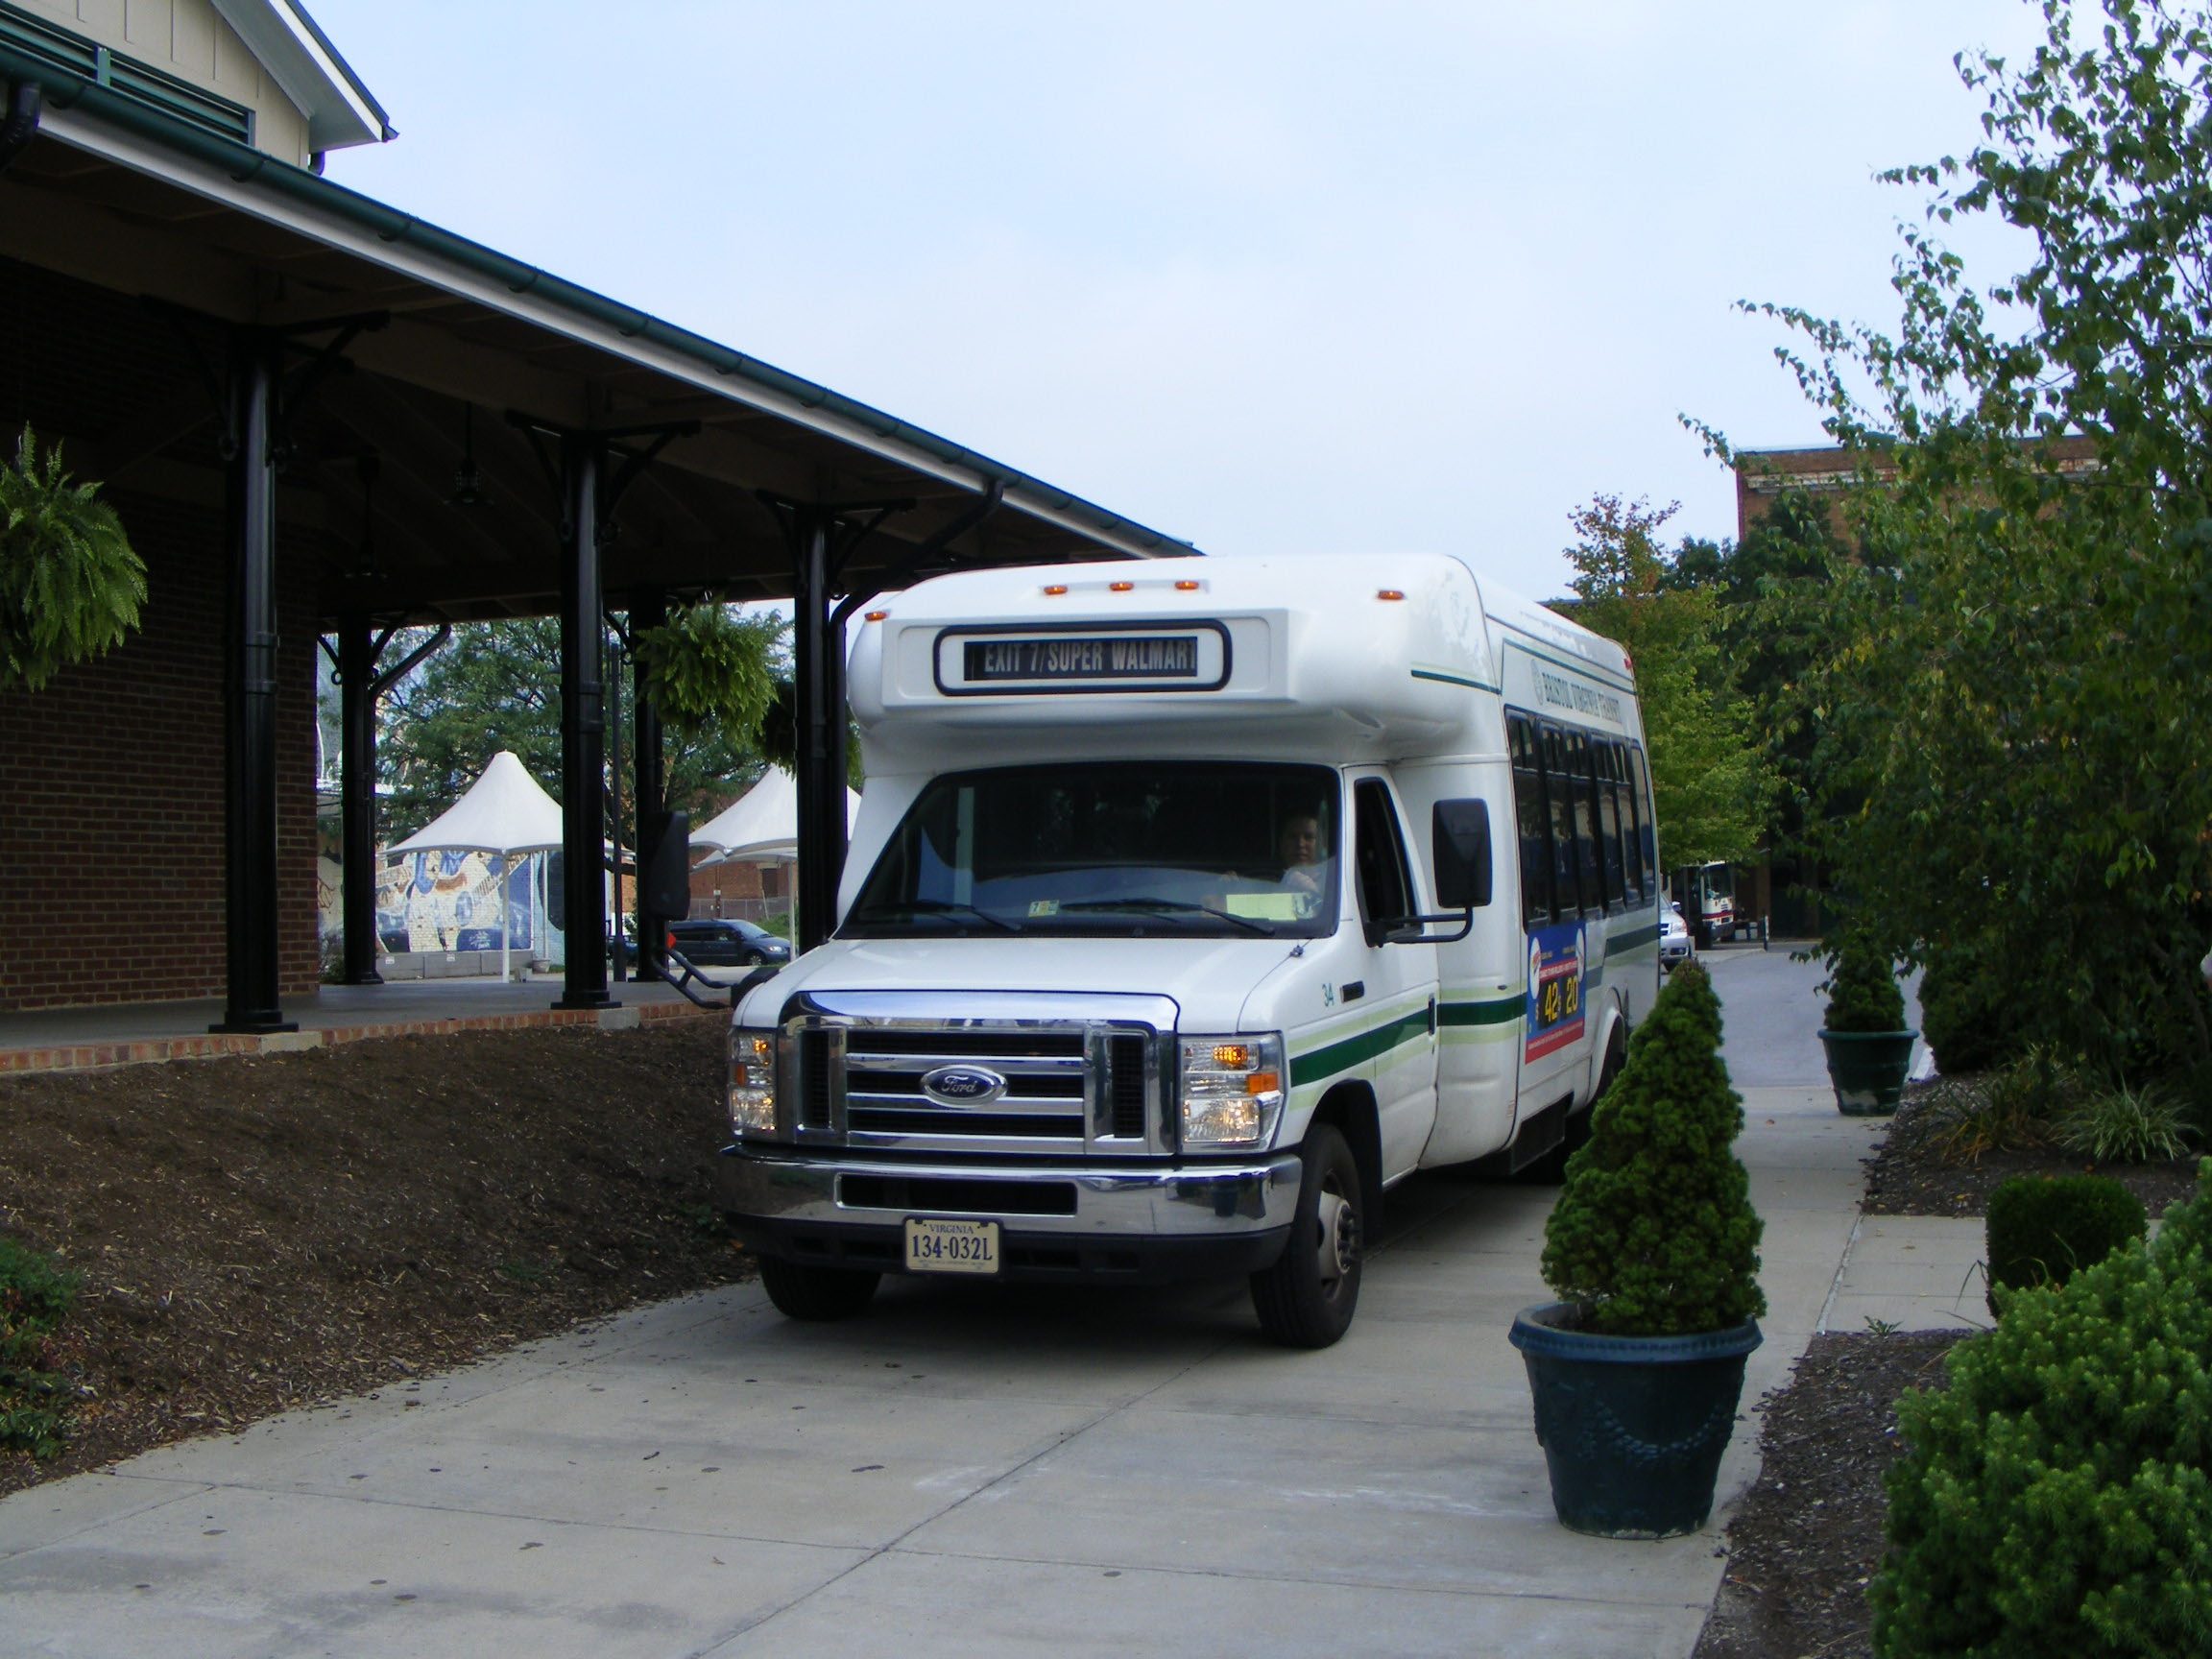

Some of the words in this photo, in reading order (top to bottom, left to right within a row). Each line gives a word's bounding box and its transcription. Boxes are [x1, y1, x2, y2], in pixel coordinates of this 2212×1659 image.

[984, 642, 1022, 672] EXIT
[1112, 638, 1197, 670] WALMART
[928, 1223, 974, 1235] VIRGINIA
